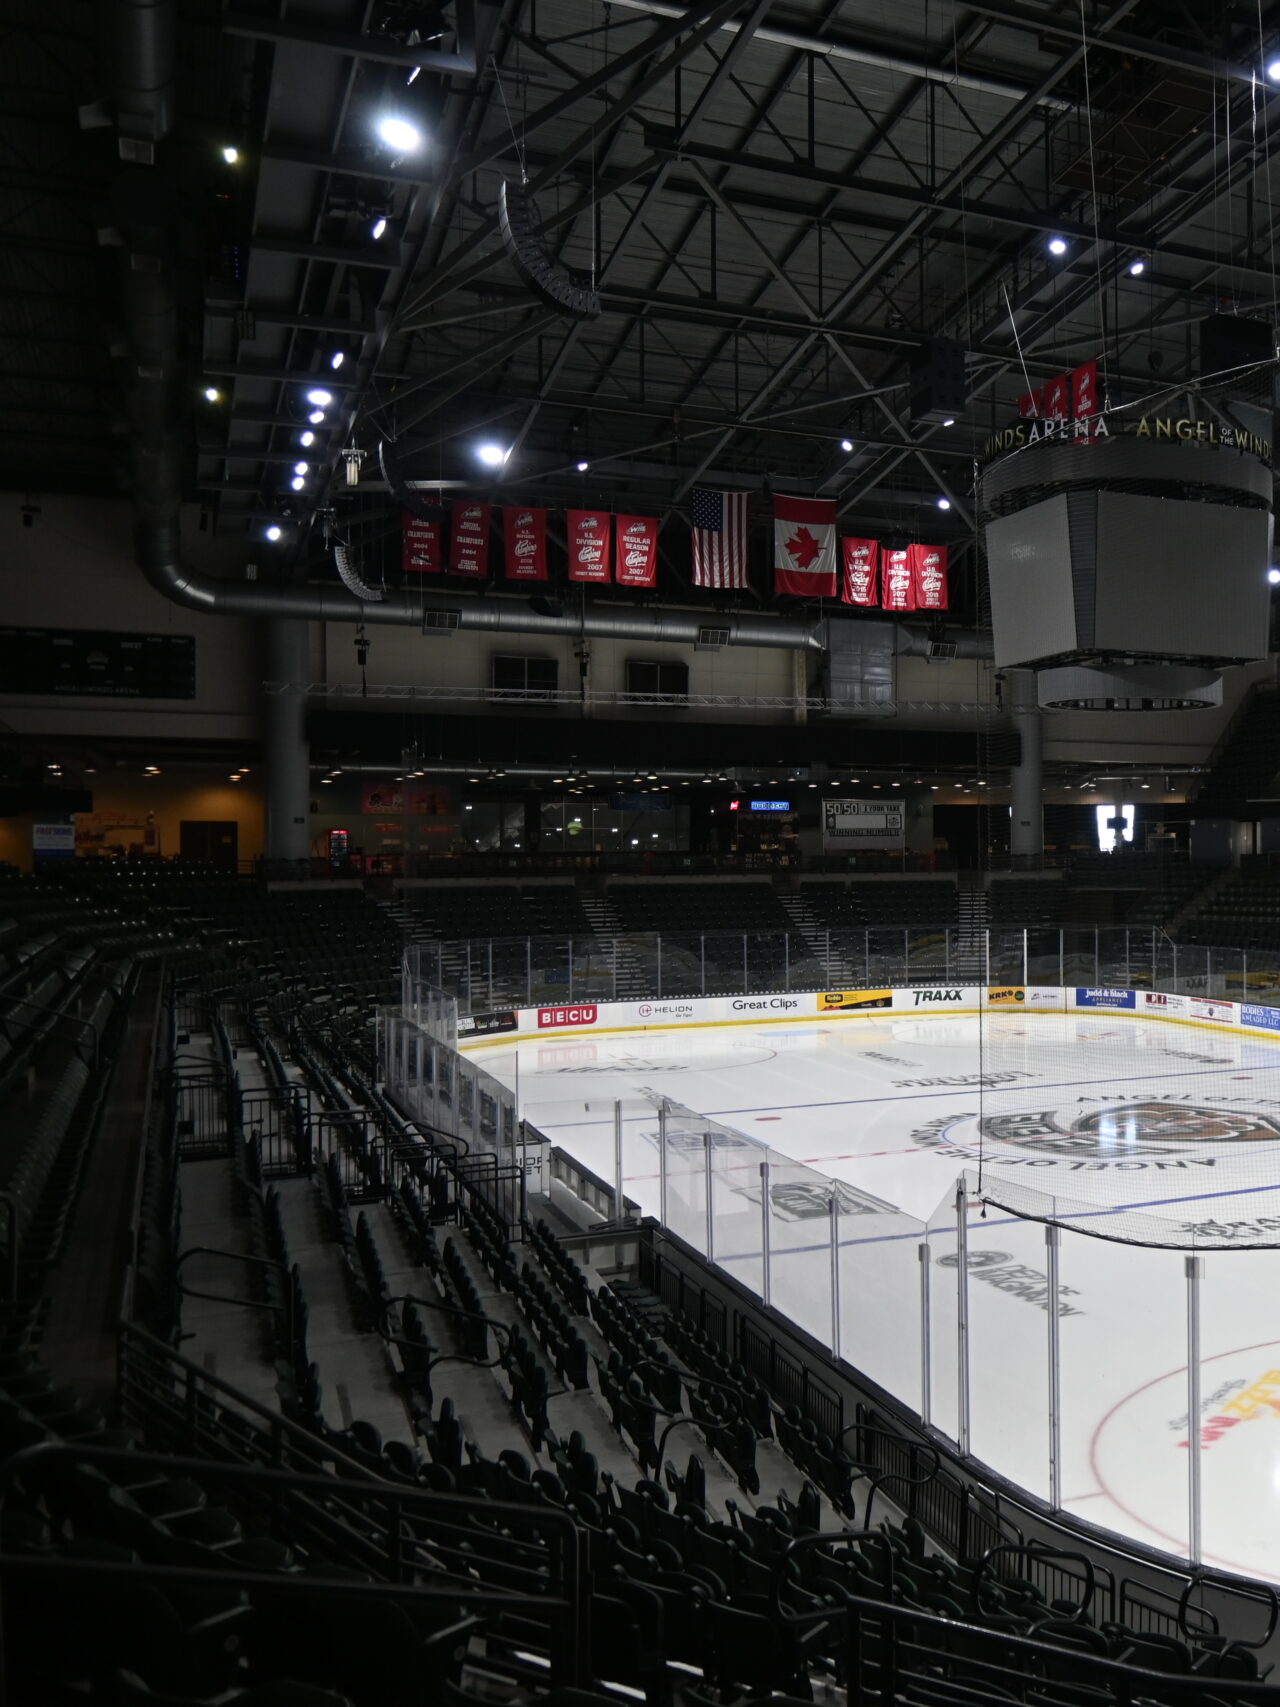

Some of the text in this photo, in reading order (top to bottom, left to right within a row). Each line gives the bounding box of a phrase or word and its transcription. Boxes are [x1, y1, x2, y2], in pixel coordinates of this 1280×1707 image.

[1028, 417, 1110, 444] ARENA
[1136, 415, 1218, 444] ANGEL
[1221, 427, 1232, 436] OF
[1219, 436, 1234, 445] THE
[576, 538, 603, 546] DIVISION
[623, 535, 651, 544] REGULAR
[625, 543, 649, 551] SEASON
[828, 829, 863, 837] WINNING
[912, 988, 964, 1006] TRAXX
[732, 998, 798, 1011] Great Clips
[655, 1005, 692, 1014] HELION
[1241, 1005, 1264, 1017] BODIES
[1067, 1158, 1217, 1170] ANGEL
